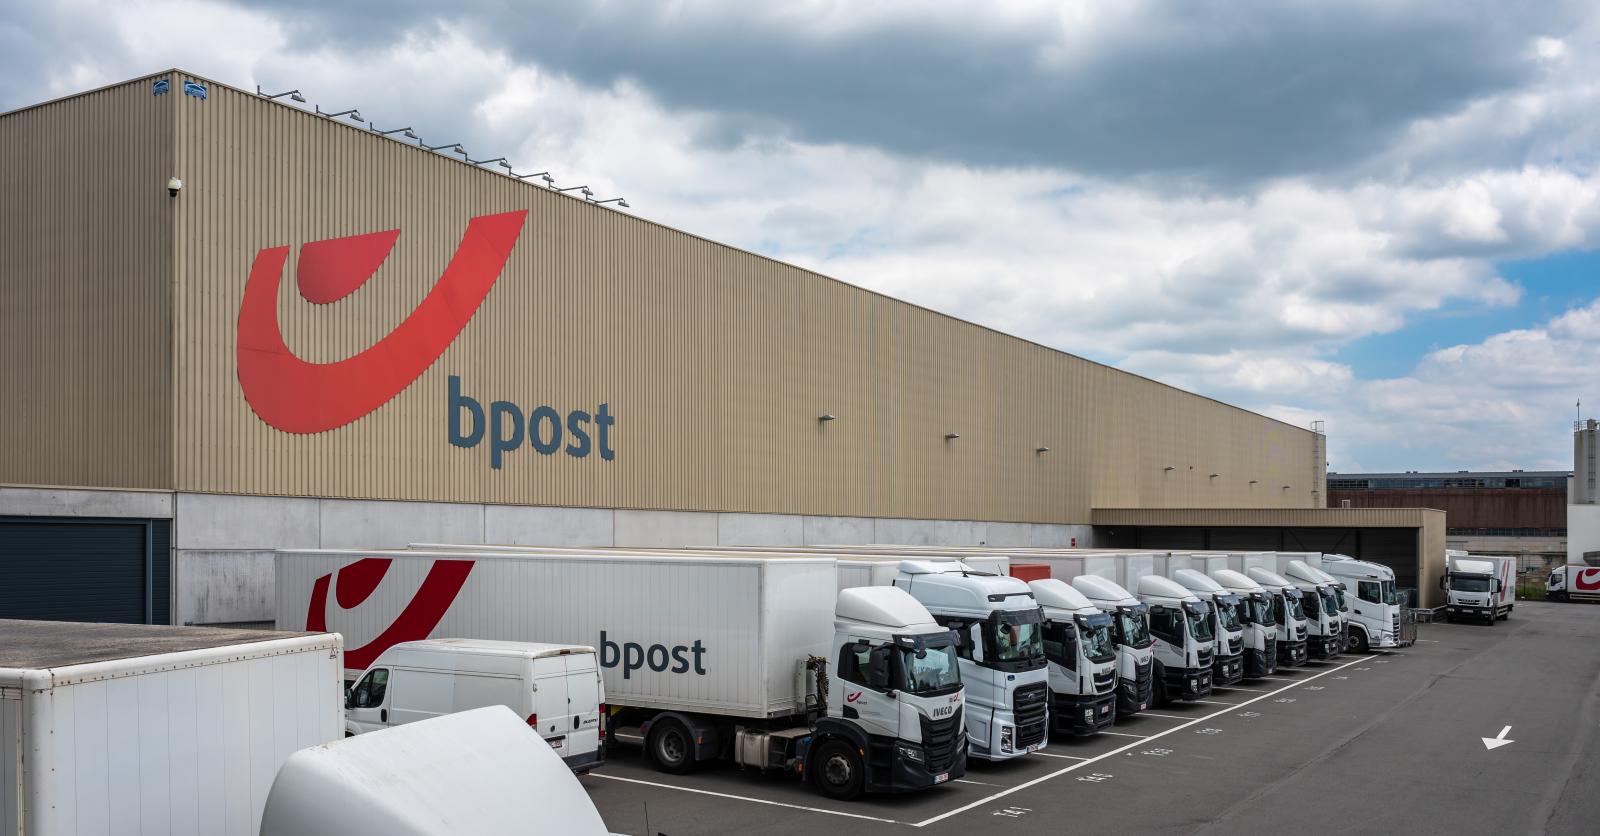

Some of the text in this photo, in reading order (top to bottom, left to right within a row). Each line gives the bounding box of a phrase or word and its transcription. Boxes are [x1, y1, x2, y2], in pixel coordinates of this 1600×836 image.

[448, 375, 616, 470] bpost
[600, 630, 706, 679] bpost
[933, 706, 953, 717] IVECO
